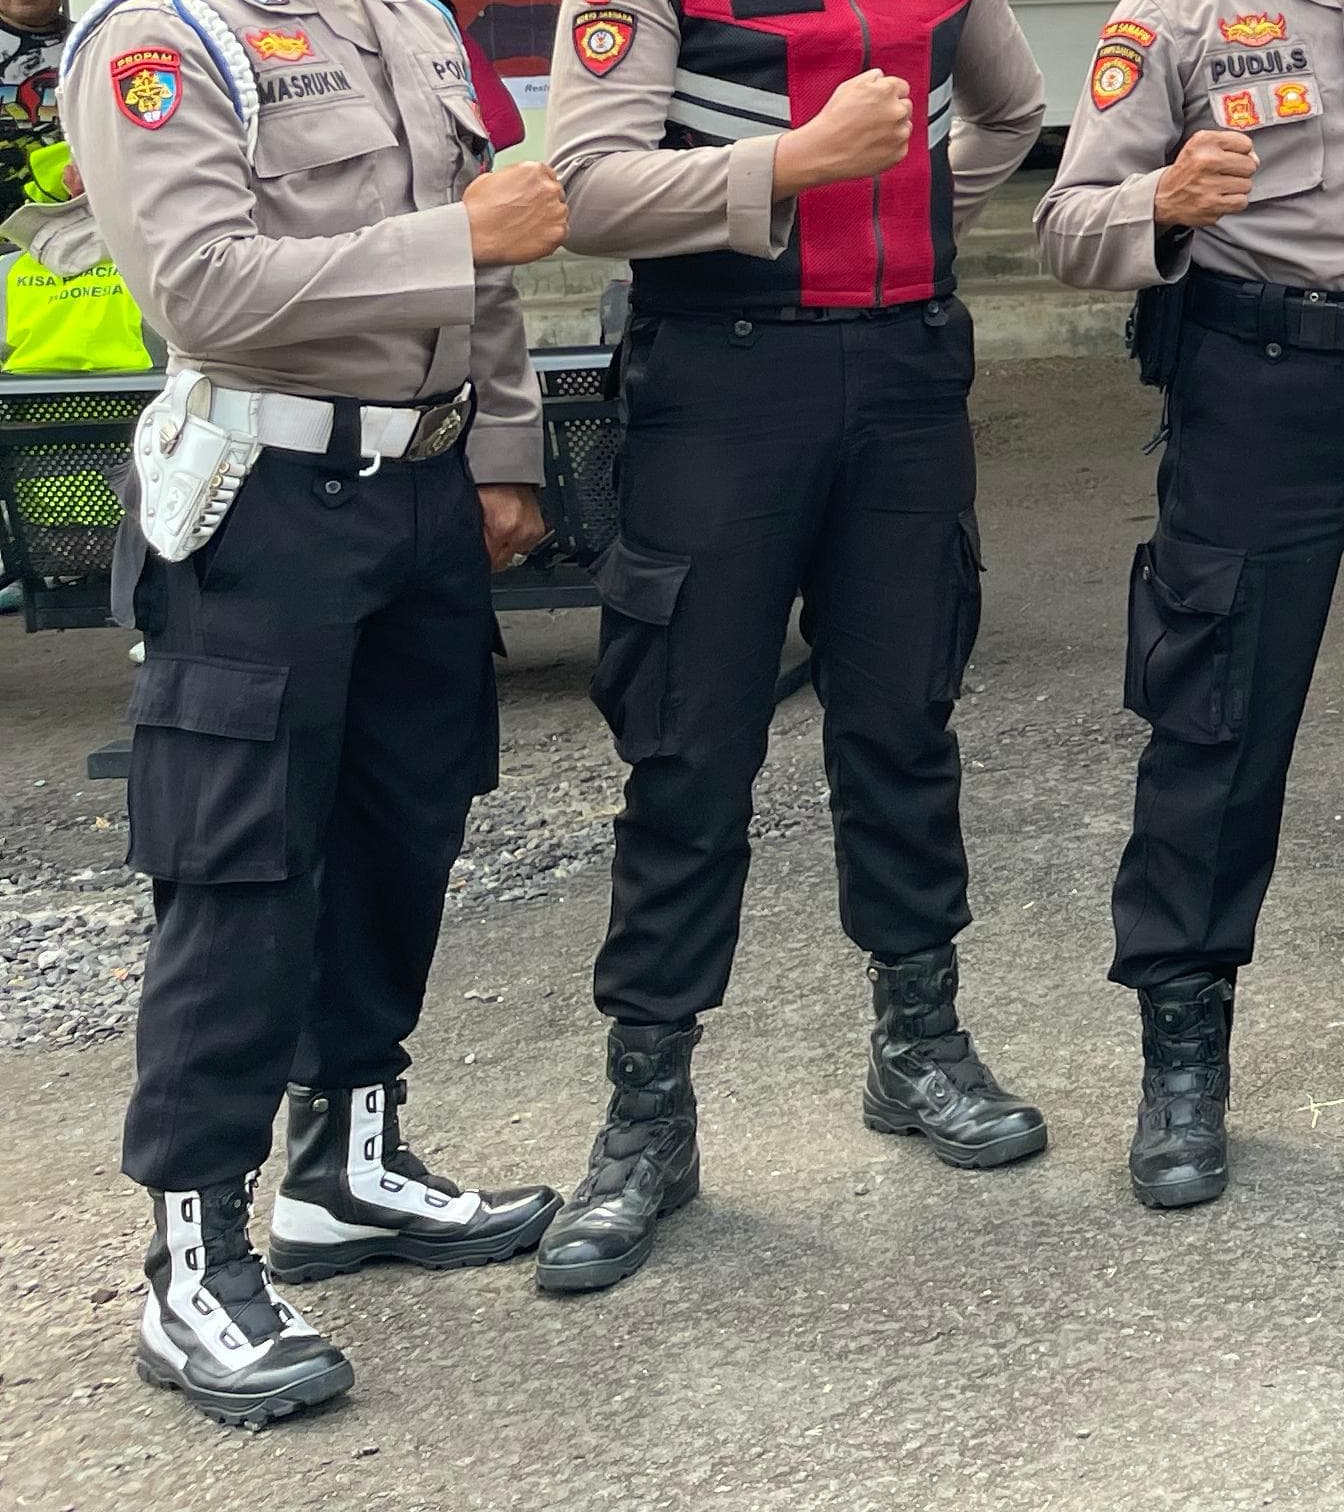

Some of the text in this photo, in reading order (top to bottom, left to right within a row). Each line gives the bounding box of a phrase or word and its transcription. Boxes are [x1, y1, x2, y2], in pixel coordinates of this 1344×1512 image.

[115, 51, 174, 70] PROPAM
[1211, 48, 1308, 83] PUDJI.S
[257, 70, 352, 106] MASRUKIN
[16, 274, 58, 287] KISA
